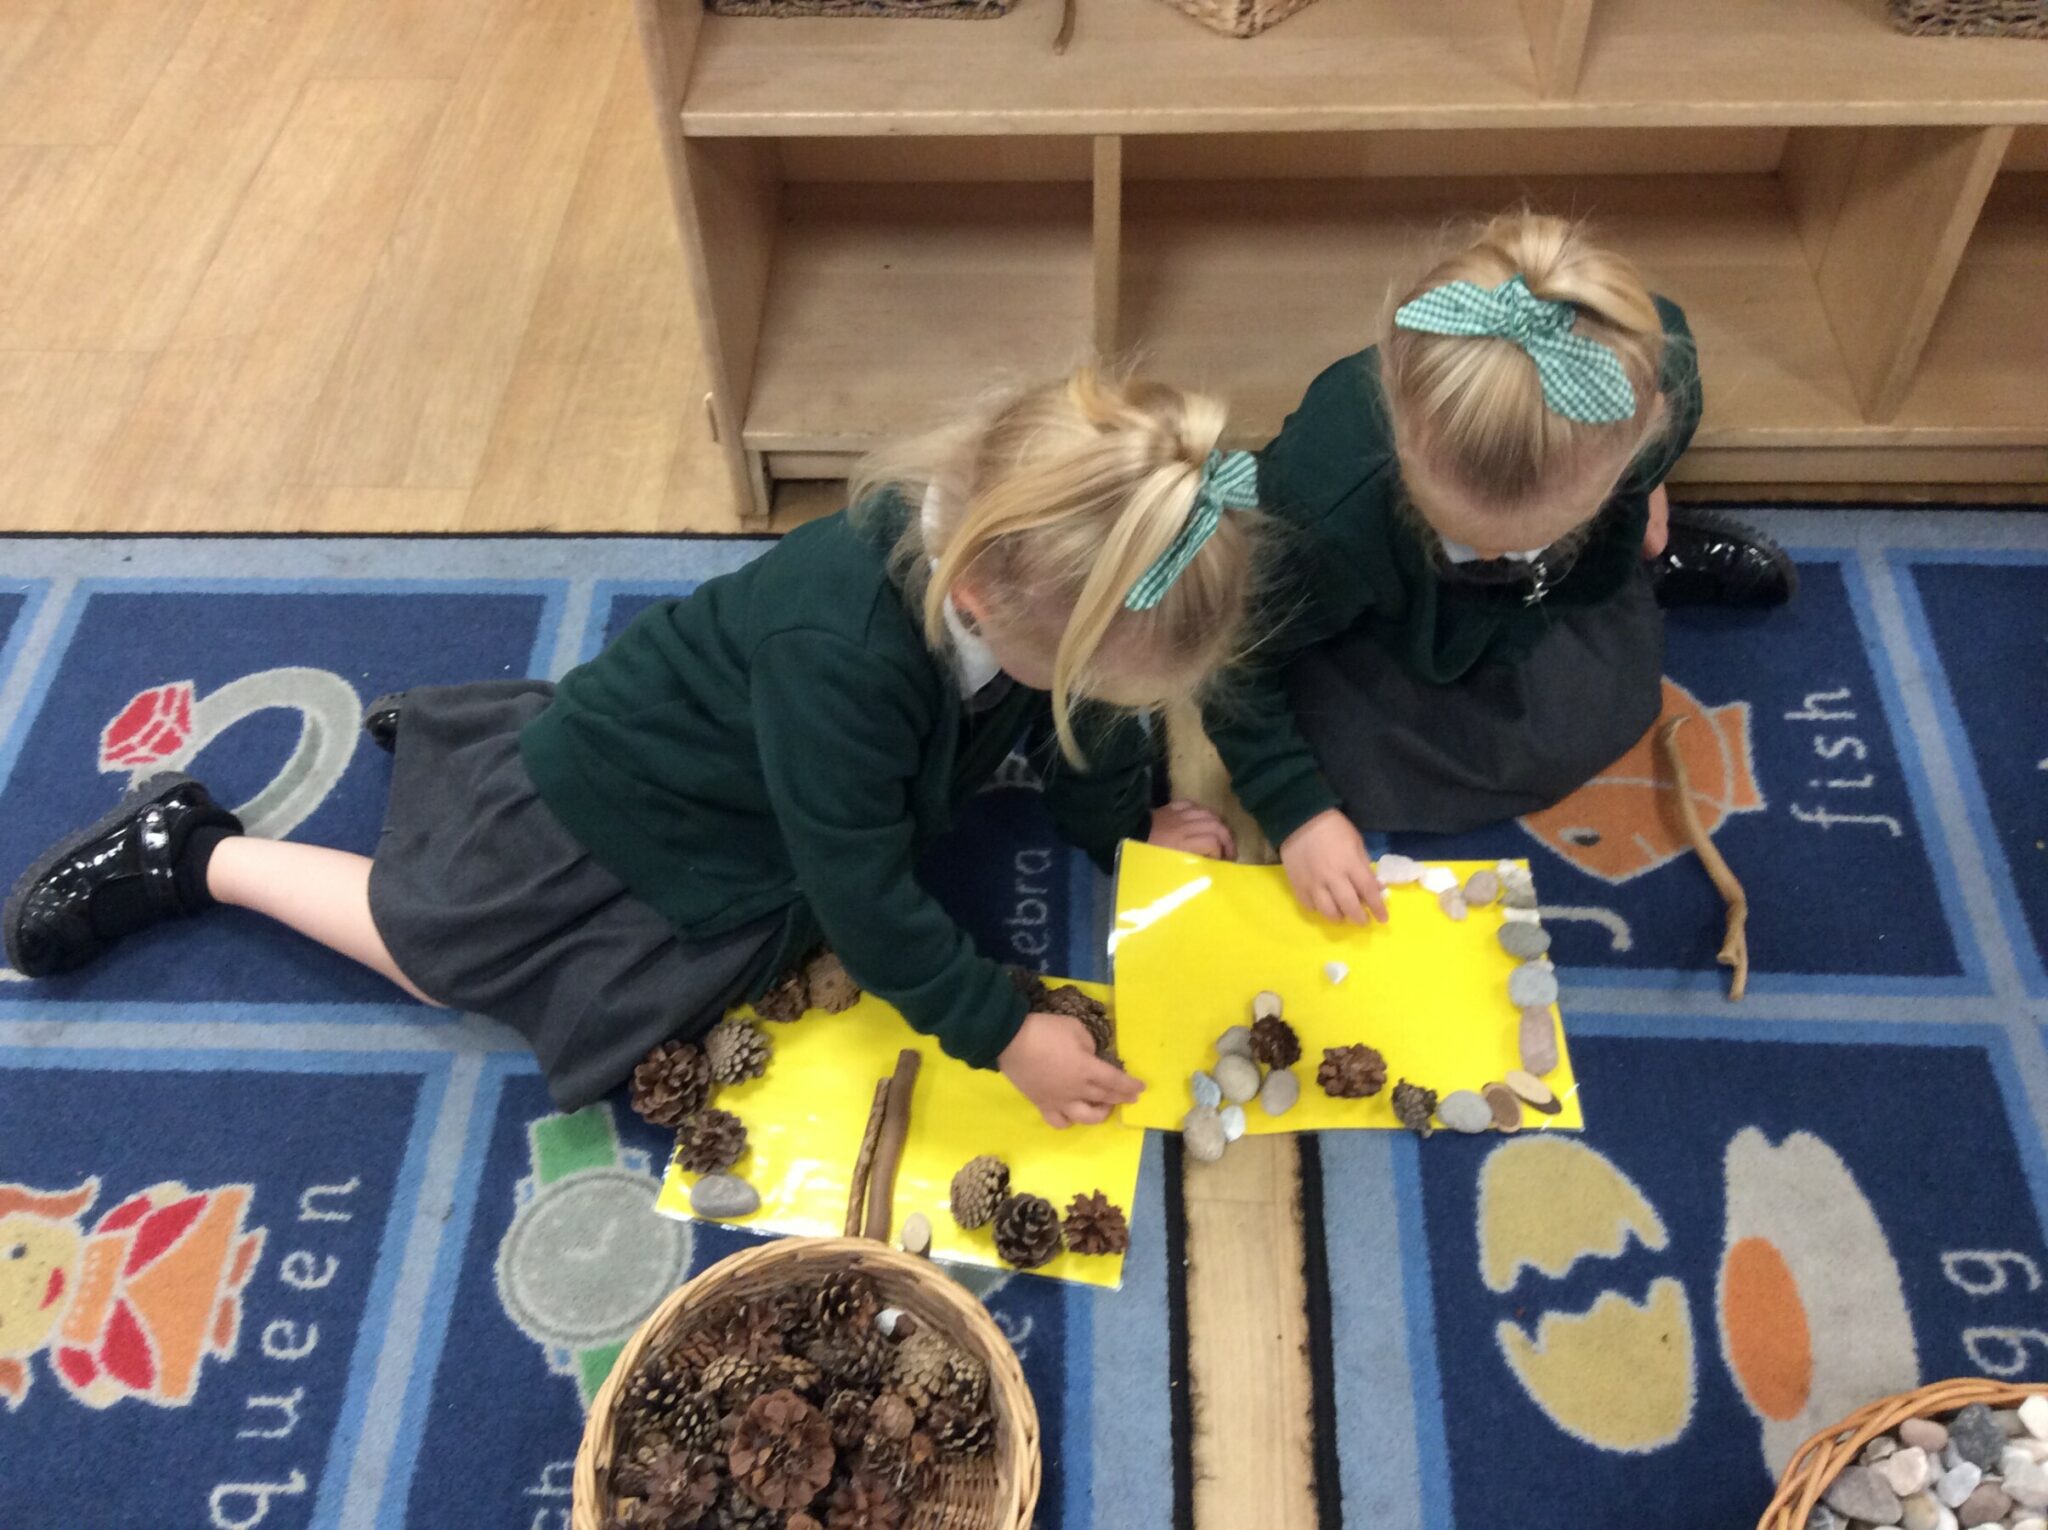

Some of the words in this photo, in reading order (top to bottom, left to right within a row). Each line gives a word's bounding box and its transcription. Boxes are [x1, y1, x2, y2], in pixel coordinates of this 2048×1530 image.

[1783, 687, 1903, 837] fish
[1004, 849, 1051, 971] ebra
[208, 1175, 361, 1530] queen
[1939, 1249, 2048, 1376] gg
